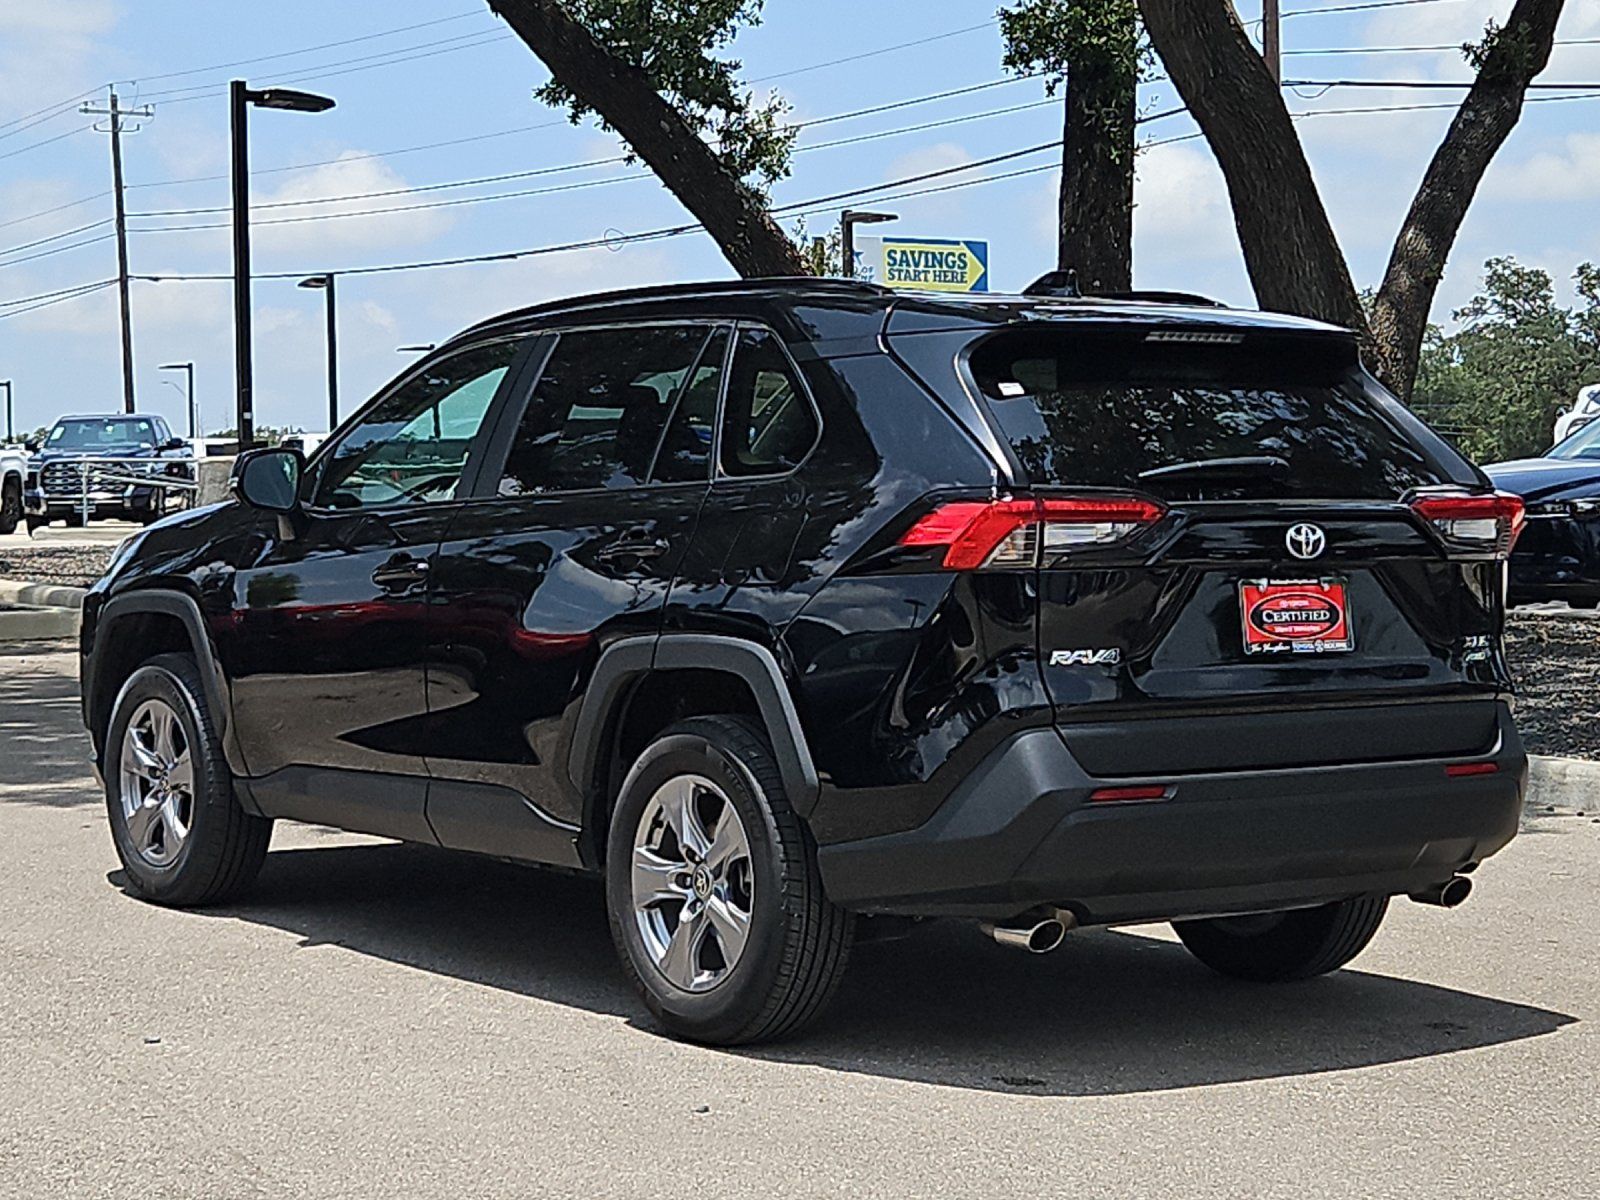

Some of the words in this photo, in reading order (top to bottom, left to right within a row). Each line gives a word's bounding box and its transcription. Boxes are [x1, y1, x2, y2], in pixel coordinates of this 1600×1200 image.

[887, 249, 968, 270] SAVINGS
[888, 268, 931, 282] START
[933, 270, 968, 284] HERE
[1262, 610, 1330, 623] CERTIFIED
[1049, 648, 1120, 666] RAV4
